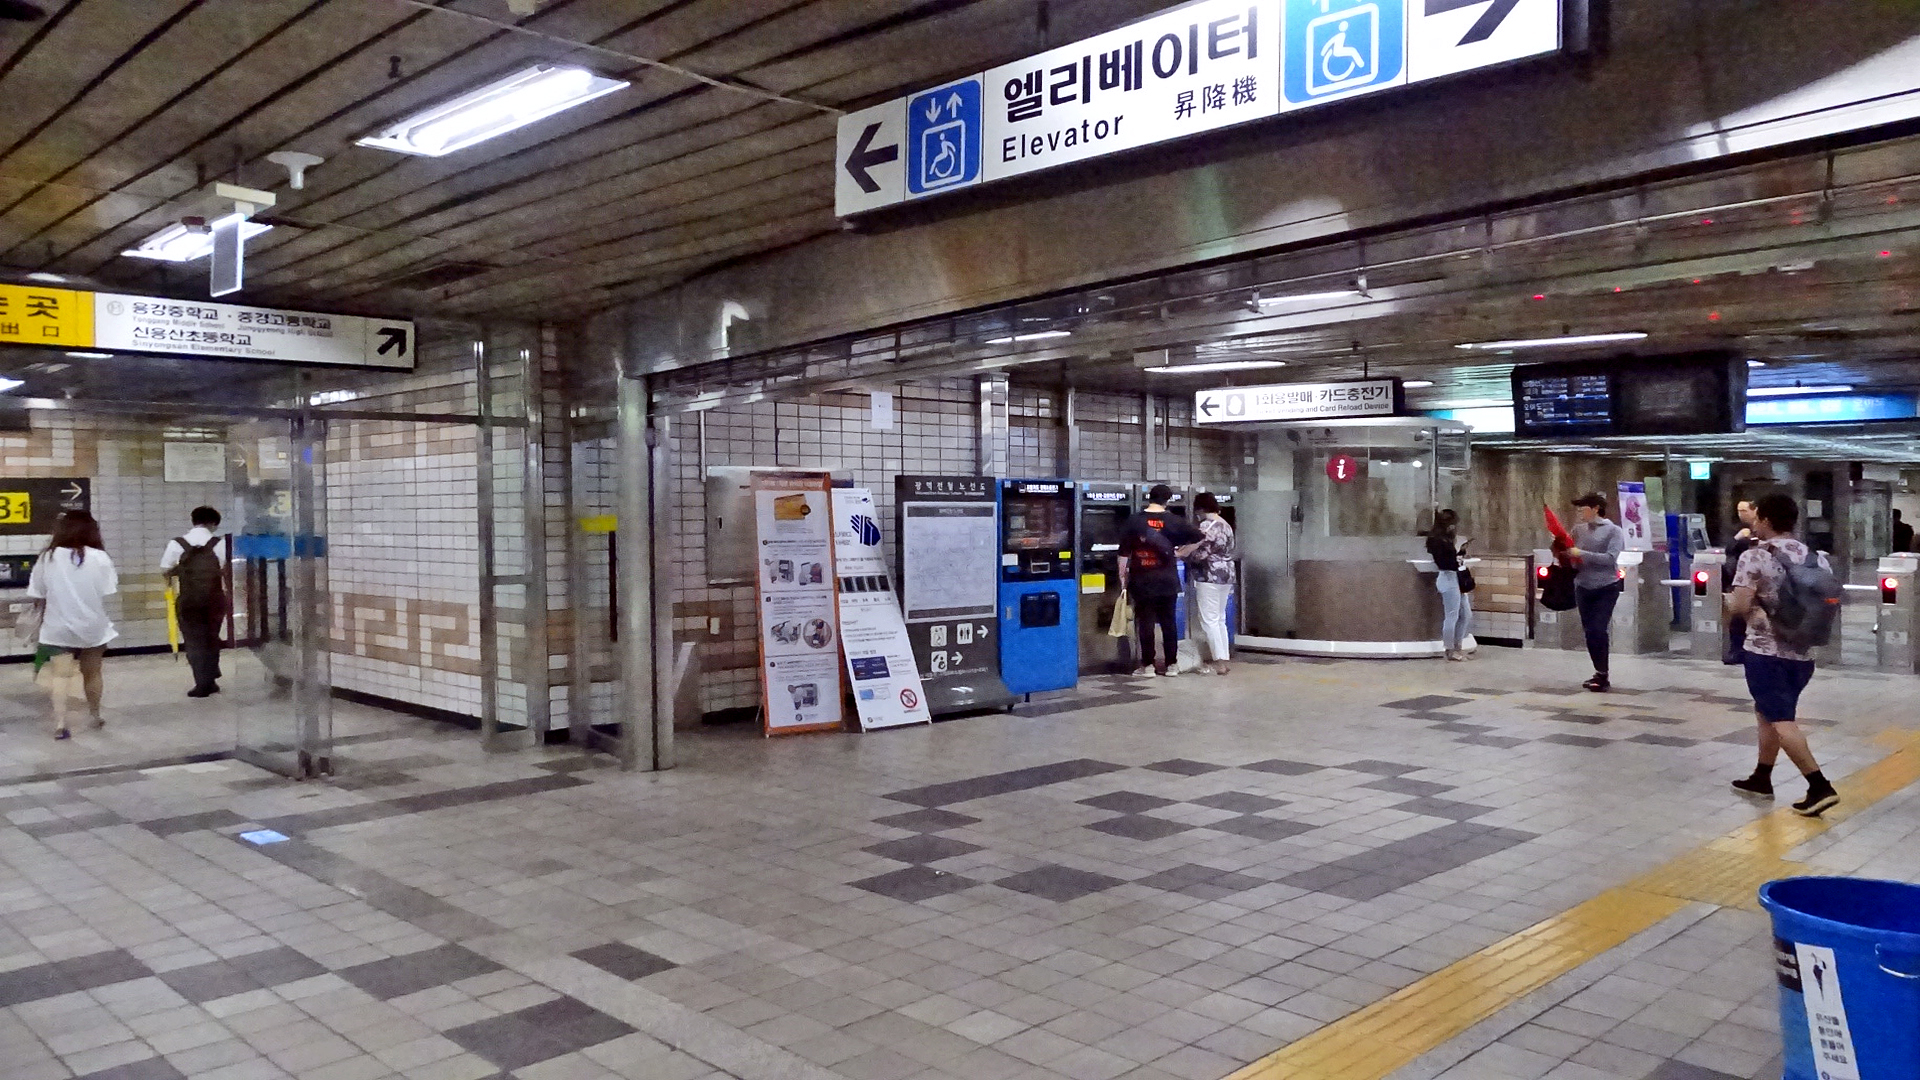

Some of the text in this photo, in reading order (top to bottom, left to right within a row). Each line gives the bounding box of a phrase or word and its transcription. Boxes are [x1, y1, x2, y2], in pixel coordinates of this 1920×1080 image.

[1004, 6, 1258, 124] 엘리베이터
[1174, 75, 1258, 120] 昇降機
[1002, 115, 1124, 163] Elevator
[133, 302, 332, 330] 용강중학교 중경고등학교
[133, 327, 252, 346] 신용산초등학교
[245, 347, 276, 356] School
[1305, 405, 1318, 413] and
[1319, 404, 1336, 413] Card
[1338, 402, 1363, 411] Reload
[1364, 401, 1389, 410] Device
